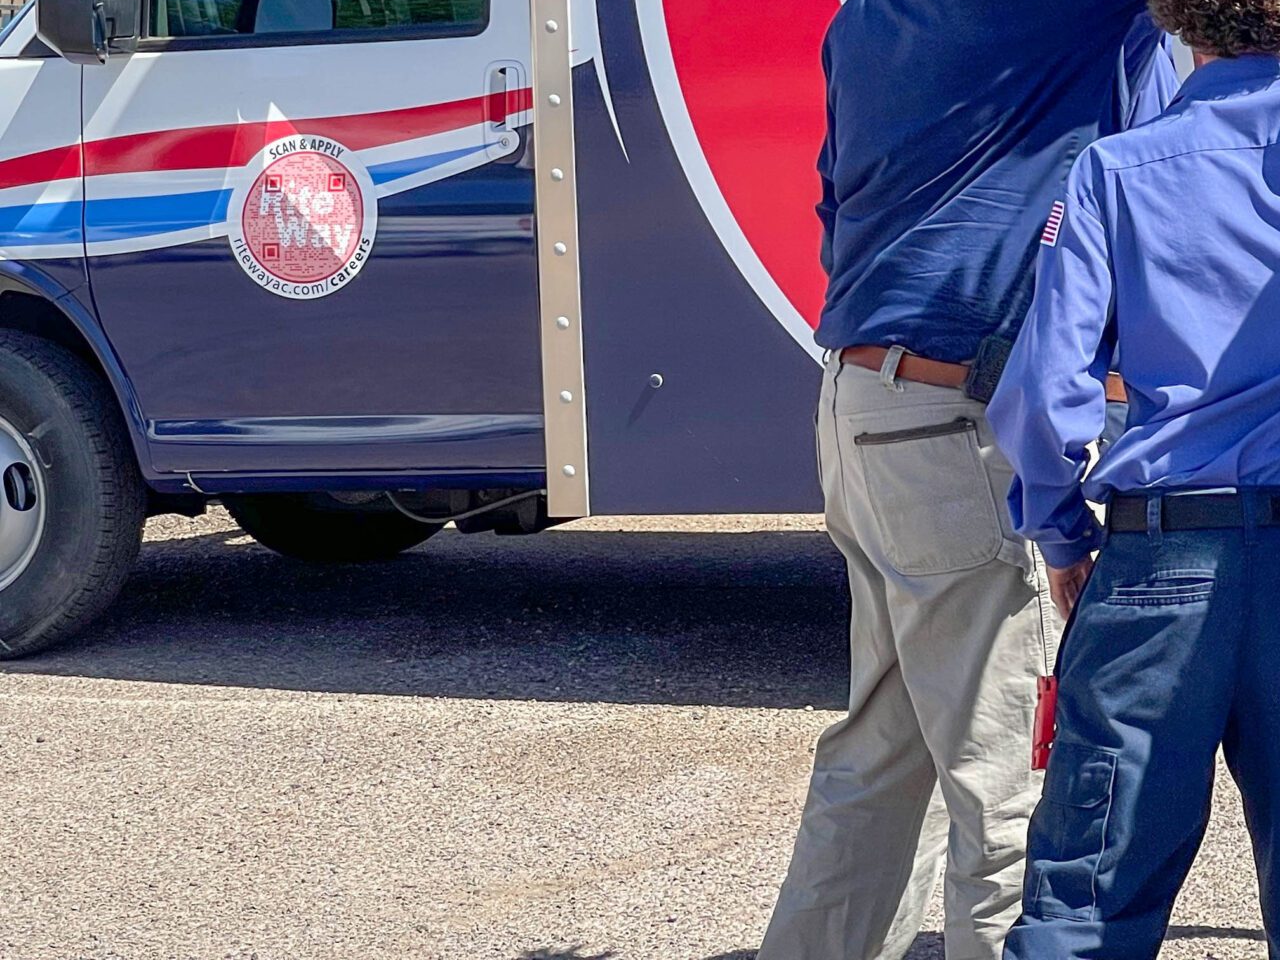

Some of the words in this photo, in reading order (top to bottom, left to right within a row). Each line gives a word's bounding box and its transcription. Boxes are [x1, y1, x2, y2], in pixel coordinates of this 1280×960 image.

[269, 141, 297, 160] SCAN
[299, 138, 308, 150] &
[310, 138, 345, 159] APPLY
[233, 237, 370, 296] ritewayac.com/careers
